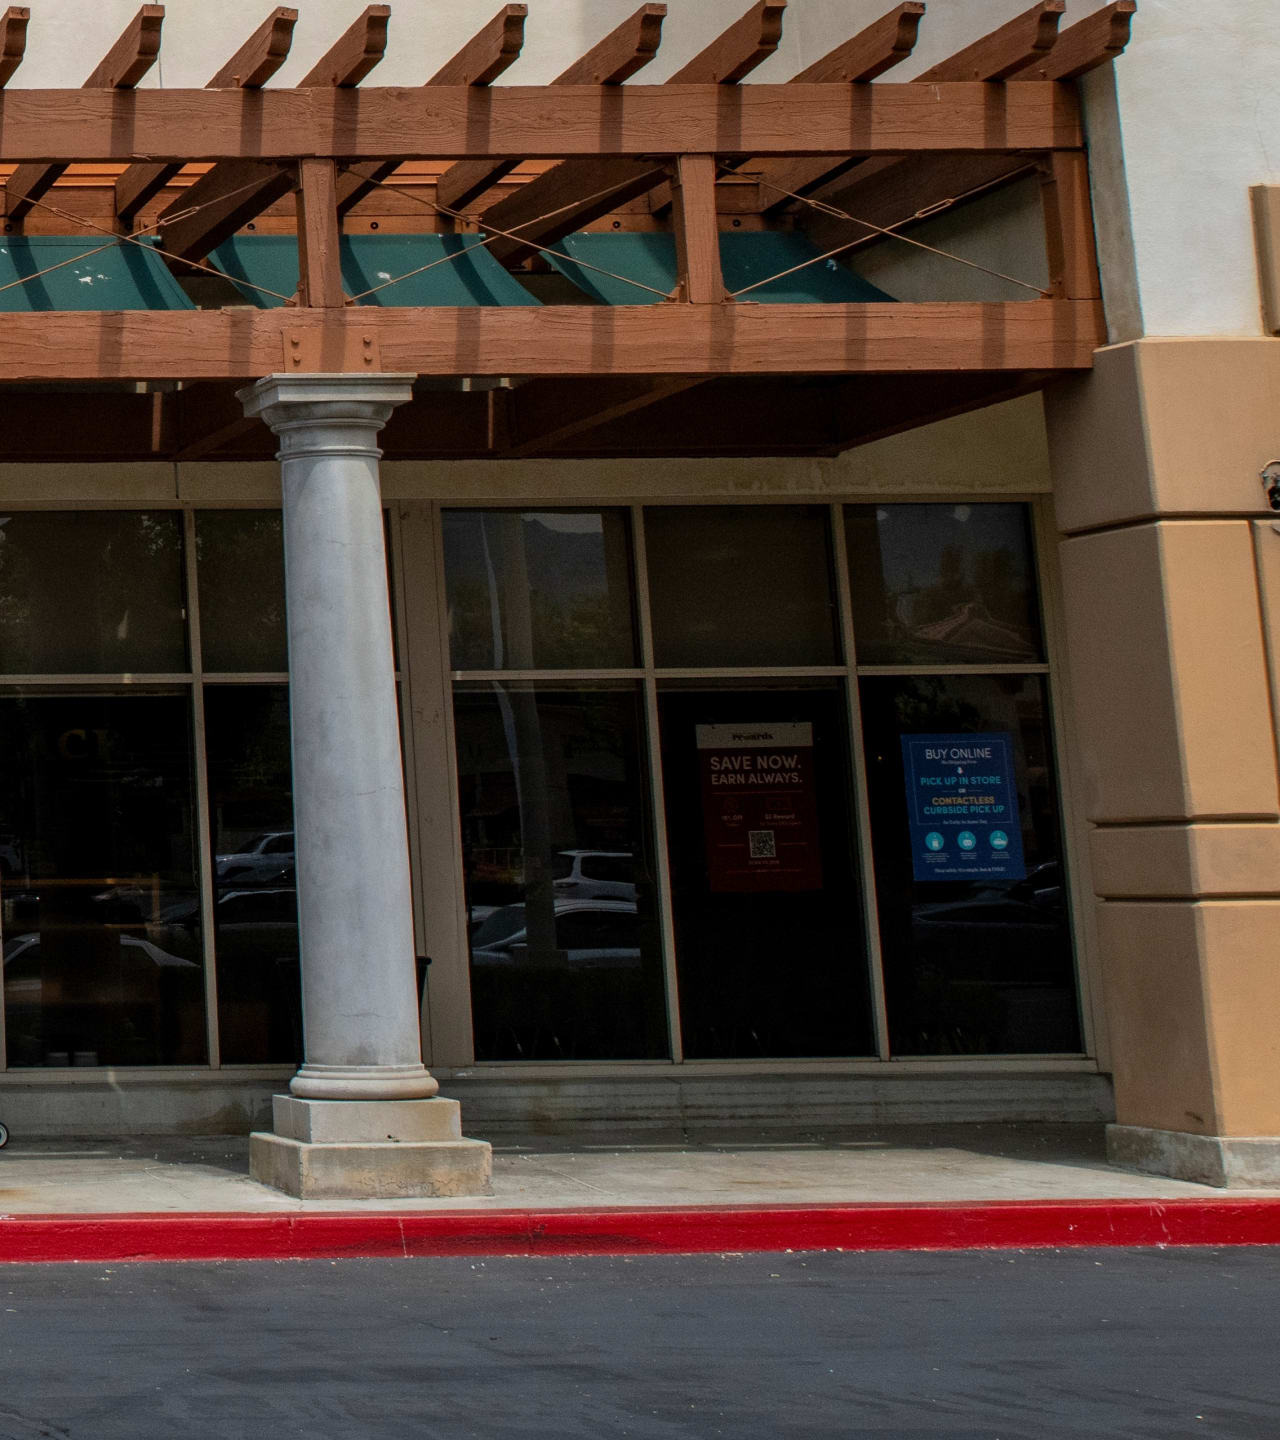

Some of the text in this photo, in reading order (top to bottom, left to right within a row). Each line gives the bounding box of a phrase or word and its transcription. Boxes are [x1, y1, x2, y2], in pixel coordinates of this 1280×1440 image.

[925, 747, 992, 759] BUY ONLINE
[710, 754, 801, 770] SAVE NOW.
[711, 772, 802, 785] EARN ALWAYS.
[920, 776, 1001, 786] PICK UP IN STORE
[932, 796, 995, 805] CONTACTLESS
[924, 804, 1005, 815] CURBSIDE PICK UP
